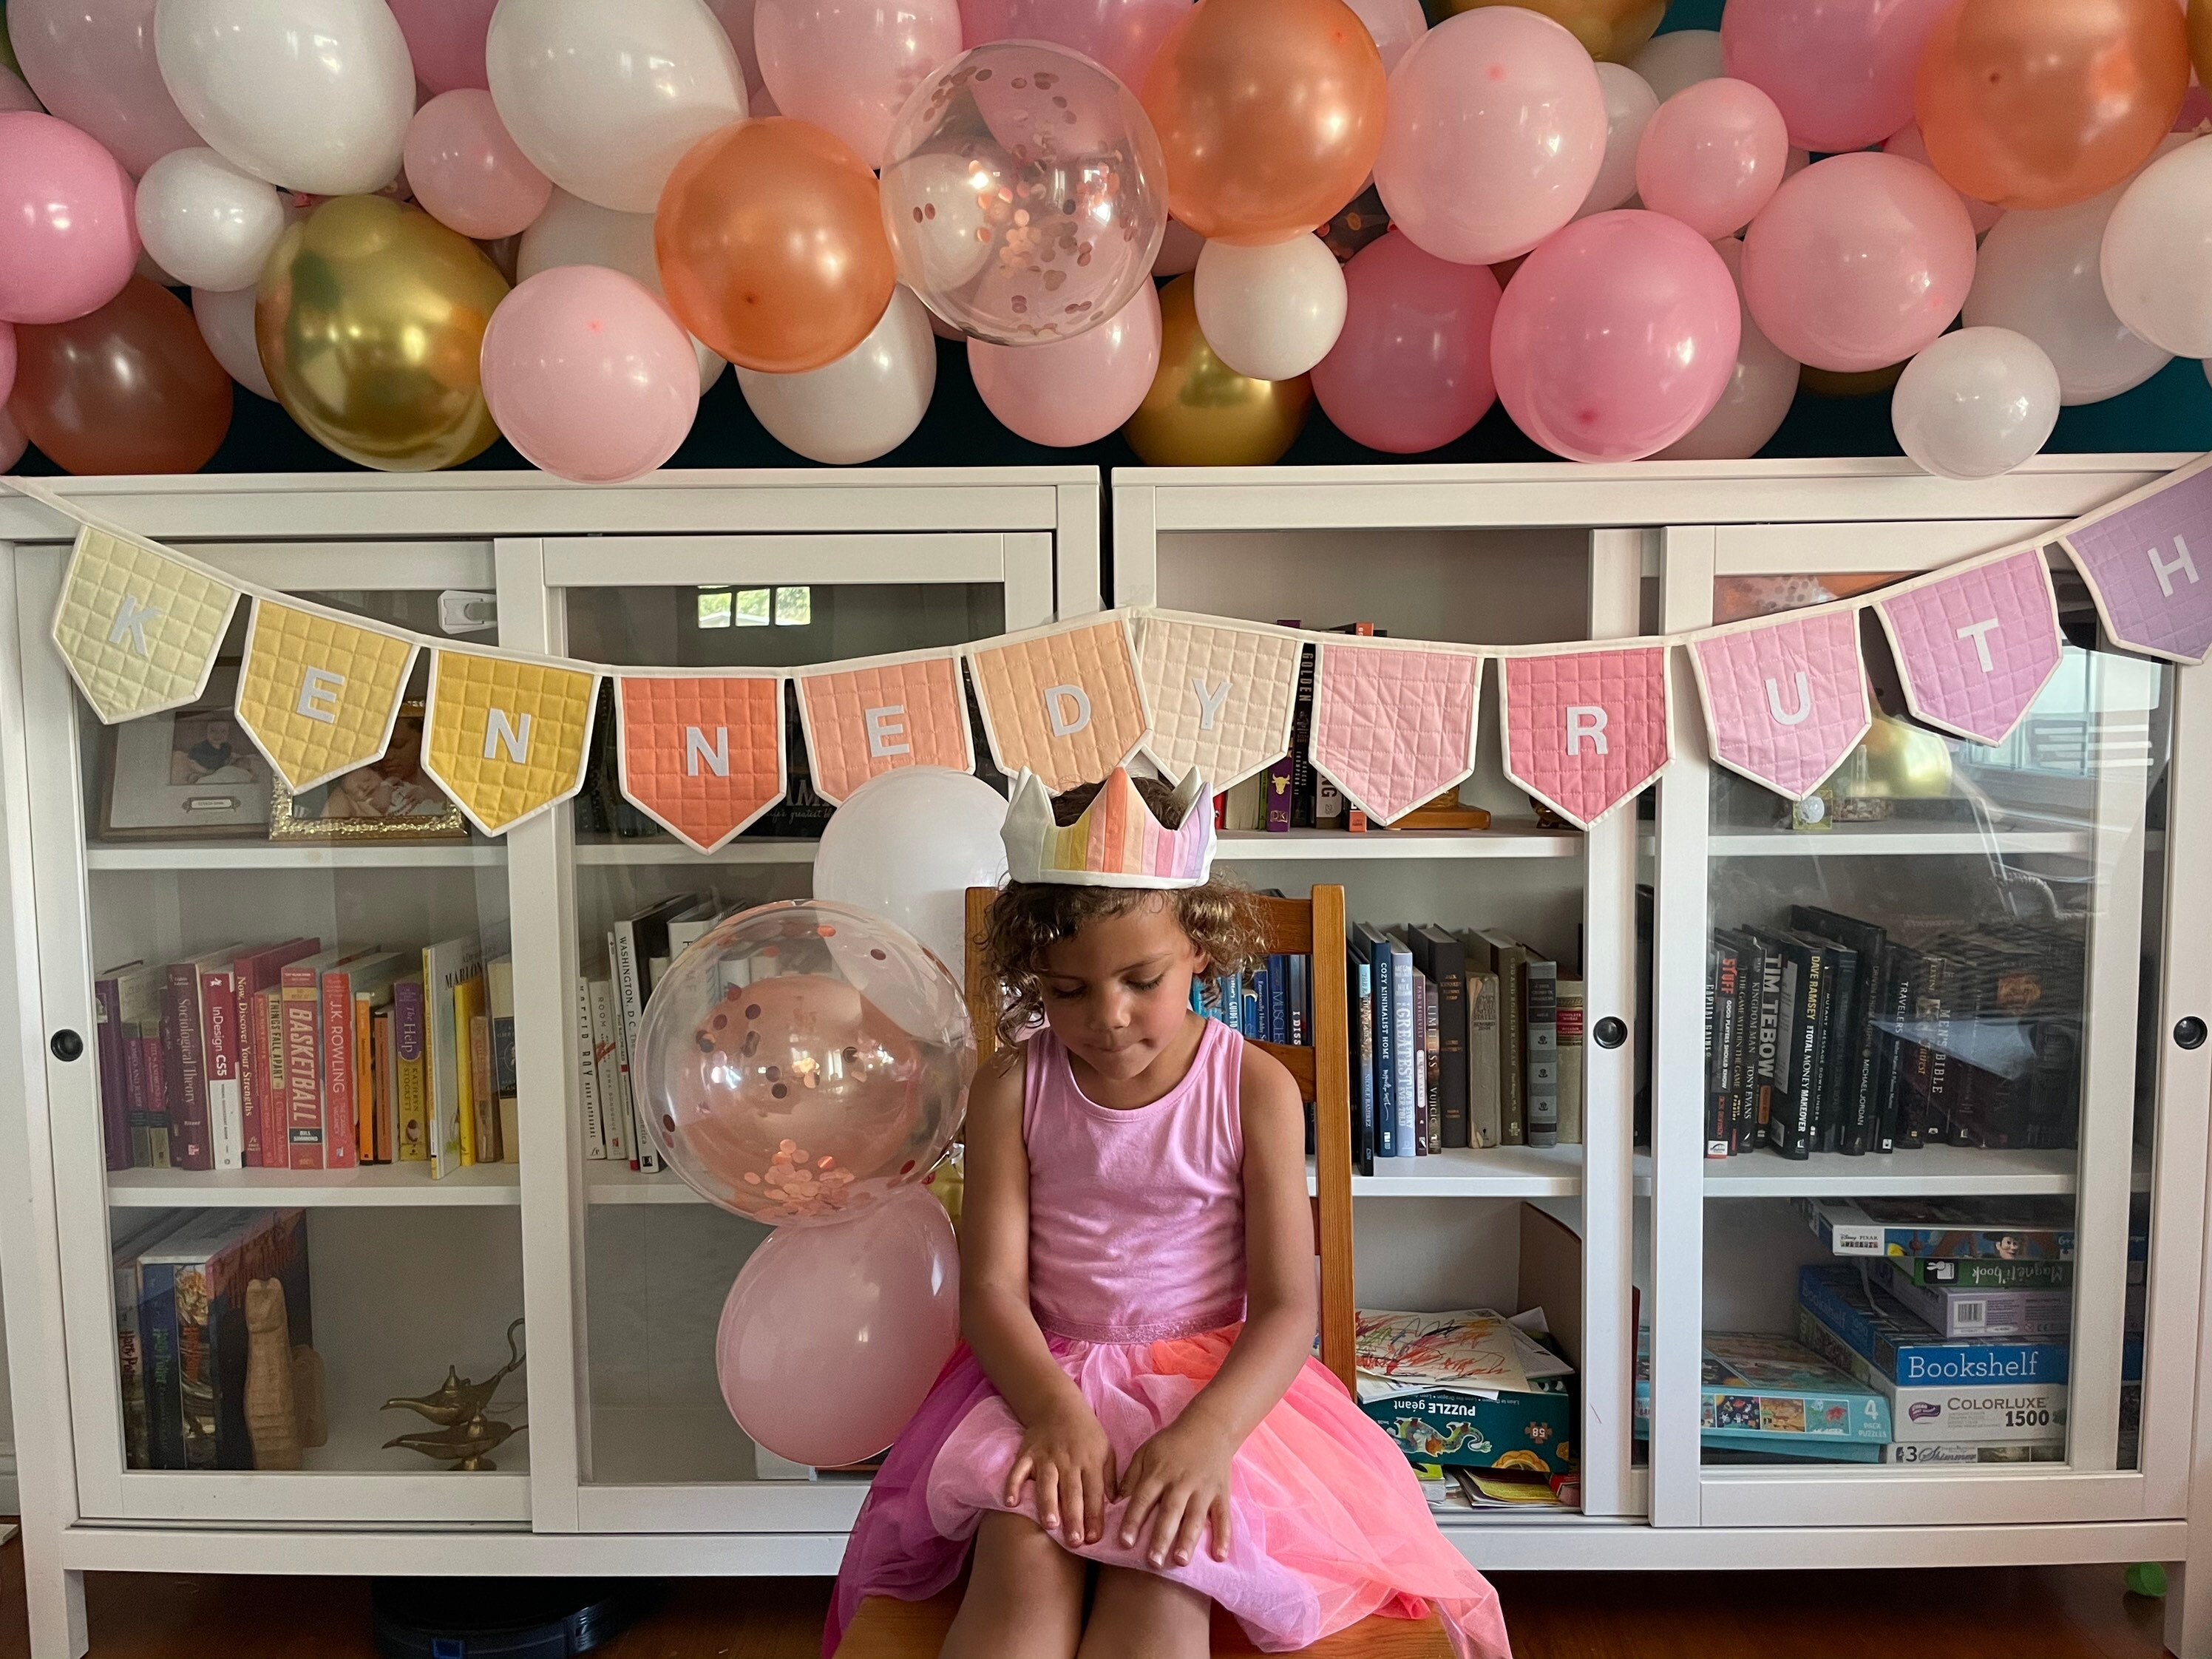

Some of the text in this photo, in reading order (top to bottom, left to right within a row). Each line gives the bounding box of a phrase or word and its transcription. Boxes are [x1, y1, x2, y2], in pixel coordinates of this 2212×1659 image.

[1299, 653, 1314, 702] GOLDEN
[1720, 958, 1737, 994] STUFF
[1807, 956, 1821, 1020] DAVE RAMSEY
[1871, 966, 1879, 994] DRIVEN
[1927, 964, 1937, 992] LEVINE
[330, 1001, 342, 1022] J.K.
[406, 1006, 414, 1022] The
[597, 997, 606, 1028] ROOM
[1229, 1002, 1237, 1020] GUIDE
[1272, 991, 1284, 1044] MUSCLES
[1737, 996, 1745, 1015] GAME
[1749, 982, 1760, 1028] KINGDOM
[1758, 954, 1782, 1078] TIM TEBOW
[1896, 981, 1908, 1034] TRAVELERS
[239, 1002, 248, 1043] Discover
[401, 1023, 415, 1053] Help
[1736, 1016, 1744, 1047] WITHIN
[177, 999, 197, 1105] Sociological Theory
[212, 1007, 226, 1076] InDesign CS5
[270, 1000, 282, 1080] THINGS FALL APART
[1396, 1008, 1411, 1085] GREATEST
[1748, 1031, 1757, 1054] MAN
[1819, 1030, 1828, 1064] MESSAGE
[1933, 1009, 1951, 1094] MEN'S BIBLE
[241, 1046, 251, 1068] Your
[289, 1008, 316, 1122] BASKETBALL
[331, 1026, 345, 1093] ROWLING
[1428, 1005, 1437, 1124] LIMITLESS VUJICIC
[1917, 1042, 1930, 1075] Fairest
[243, 1071, 253, 1116] Strengths
[1733, 1065, 1741, 1089] GAME
[1743, 1064, 1754, 1119] TONY EVANS
[1797, 1030, 1814, 1132] TOTAL MONEY MAKEOVER
[1857, 1059, 1870, 1125] MICHAEL JORDAN
[1397, 1087, 1406, 1127] EVER TOLD
[119, 1331, 135, 1356] Harry
[1907, 1351, 2039, 1378] Bookshelf
[1394, 1400, 1476, 1416] PUZZLE géant
[1864, 1400, 1879, 1419] 4
[1947, 1397, 2047, 1410] COLORLUXE
[2005, 1410, 2050, 1427] 1500
[1532, 1428, 1545, 1437] 58
[1858, 1429, 1887, 1438] PUZZLES
[1863, 1422, 1882, 1430] PACK
